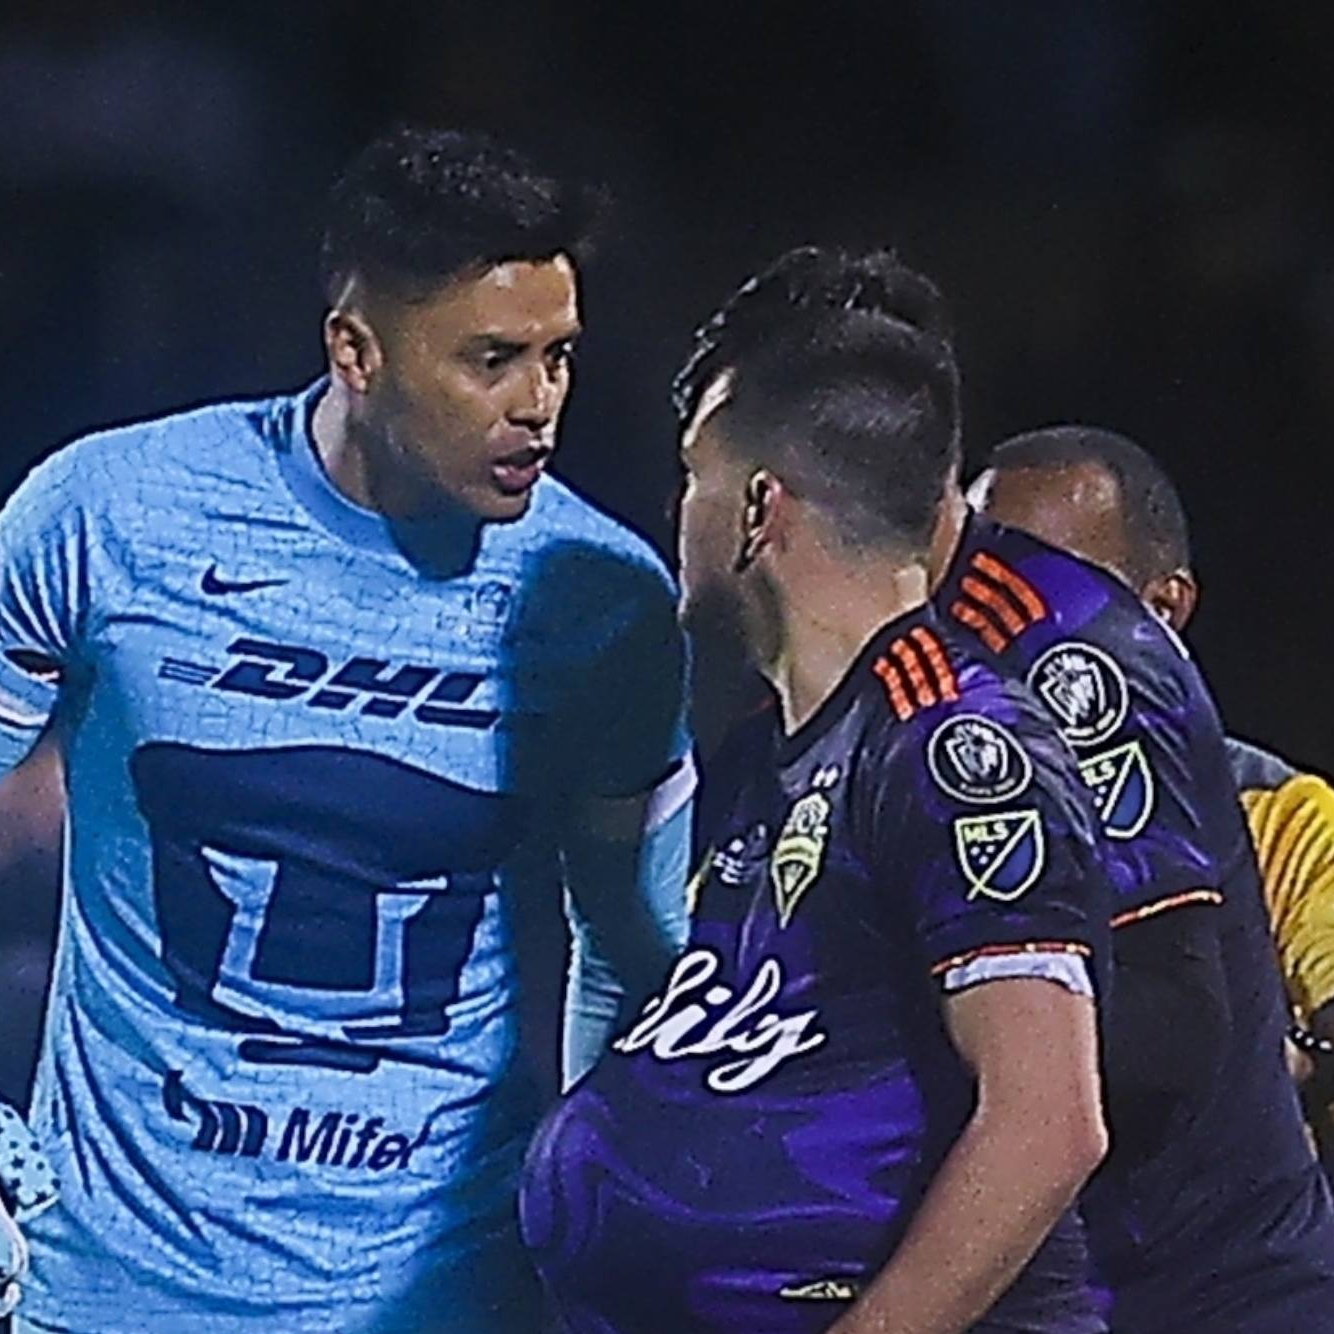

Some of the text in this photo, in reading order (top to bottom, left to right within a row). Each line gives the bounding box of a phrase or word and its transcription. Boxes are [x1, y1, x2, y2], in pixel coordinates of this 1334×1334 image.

[210, 637, 502, 730] DHL
[961, 819, 1010, 843] MLS
[612, 949, 827, 1092] lily
